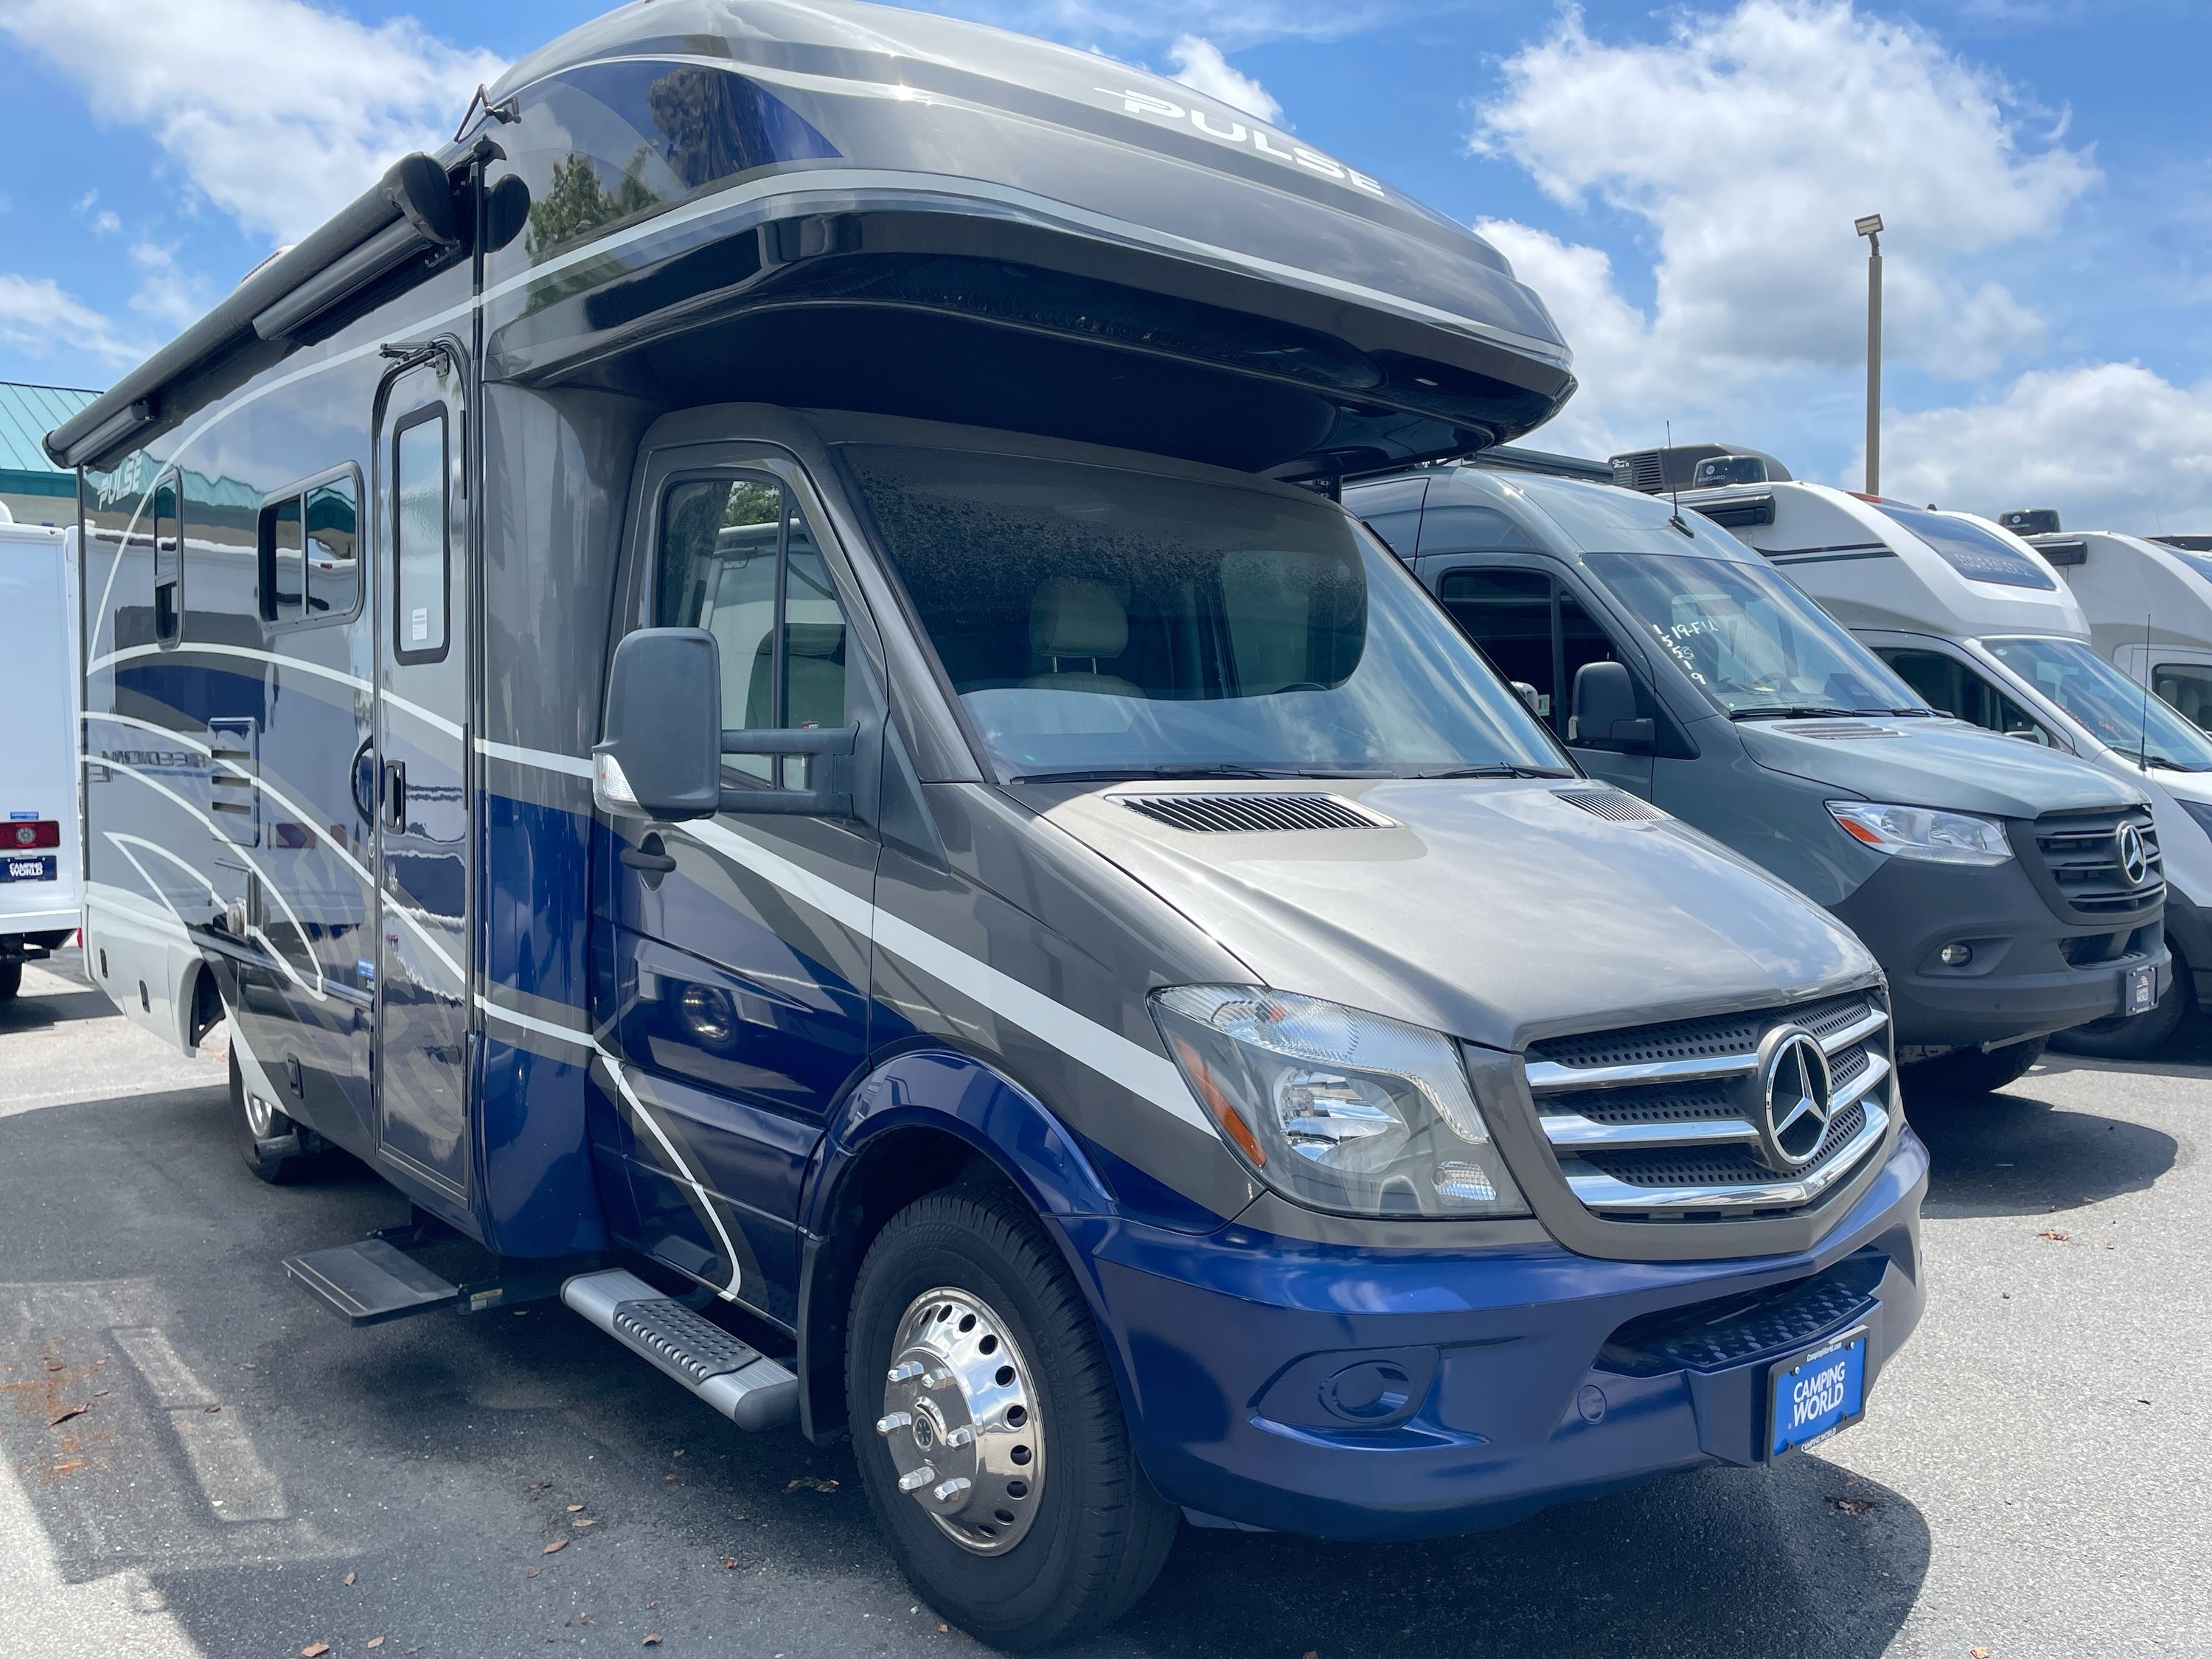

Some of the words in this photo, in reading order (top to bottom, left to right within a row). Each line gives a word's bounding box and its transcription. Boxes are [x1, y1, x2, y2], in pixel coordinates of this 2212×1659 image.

[1094, 87, 1385, 198] PULSE
[97, 453, 142, 511] PULSE
[9, 862, 43, 872] CAMPING
[10, 869, 44, 877] WORLD
[1793, 1361, 1846, 1403] CAMPING
[1793, 1382, 1845, 1427] WORLD
[1801, 1435, 1820, 1452] CAMPING
[1820, 1427, 1837, 1441] WORLD
